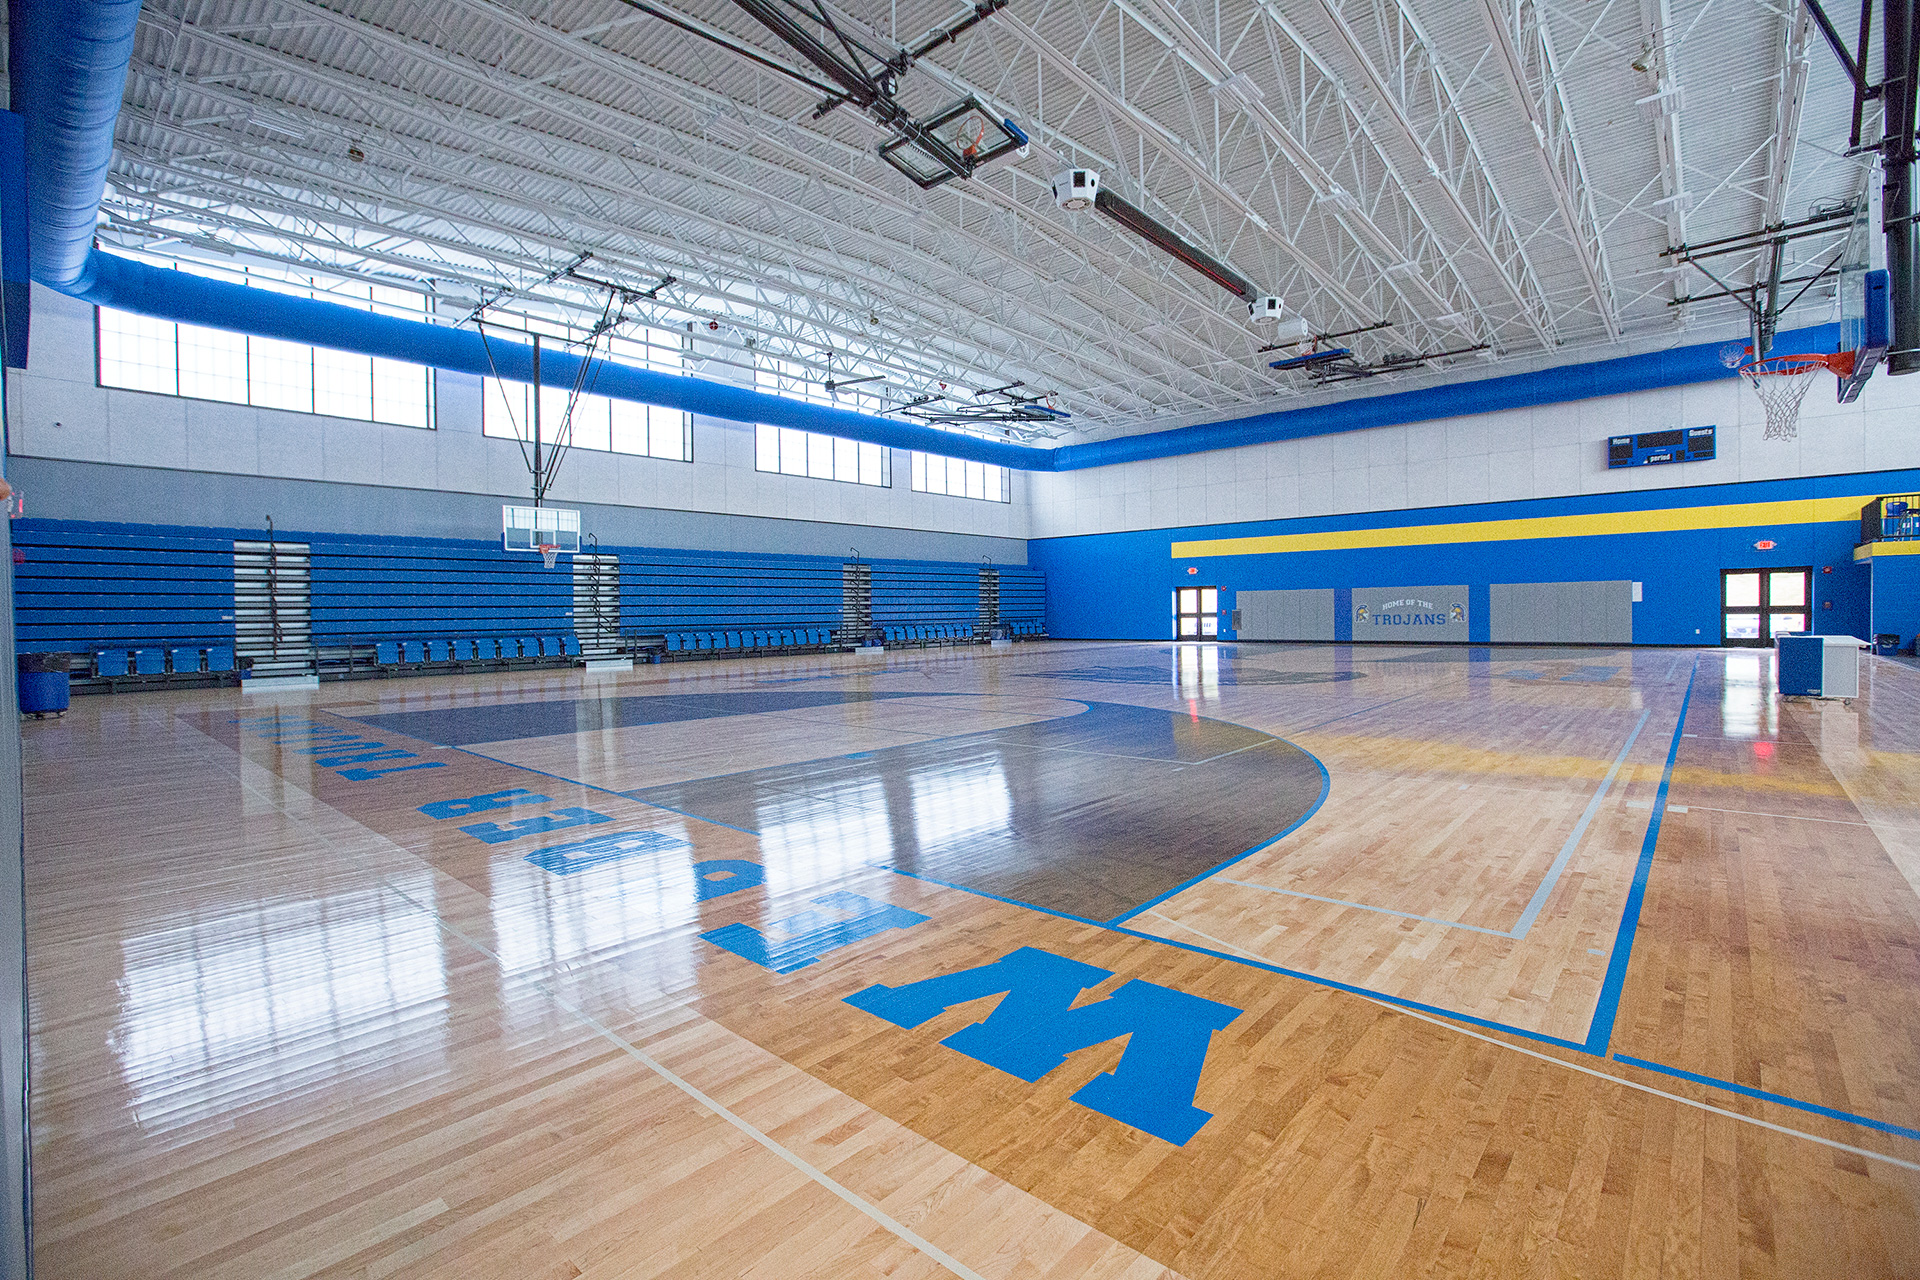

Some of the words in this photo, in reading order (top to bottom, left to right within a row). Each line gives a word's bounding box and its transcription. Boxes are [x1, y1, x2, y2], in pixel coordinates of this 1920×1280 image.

[1382, 599, 1405, 610] HOME
[1416, 600, 1434, 610] THE
[1372, 613, 1446, 625] TROJANS
